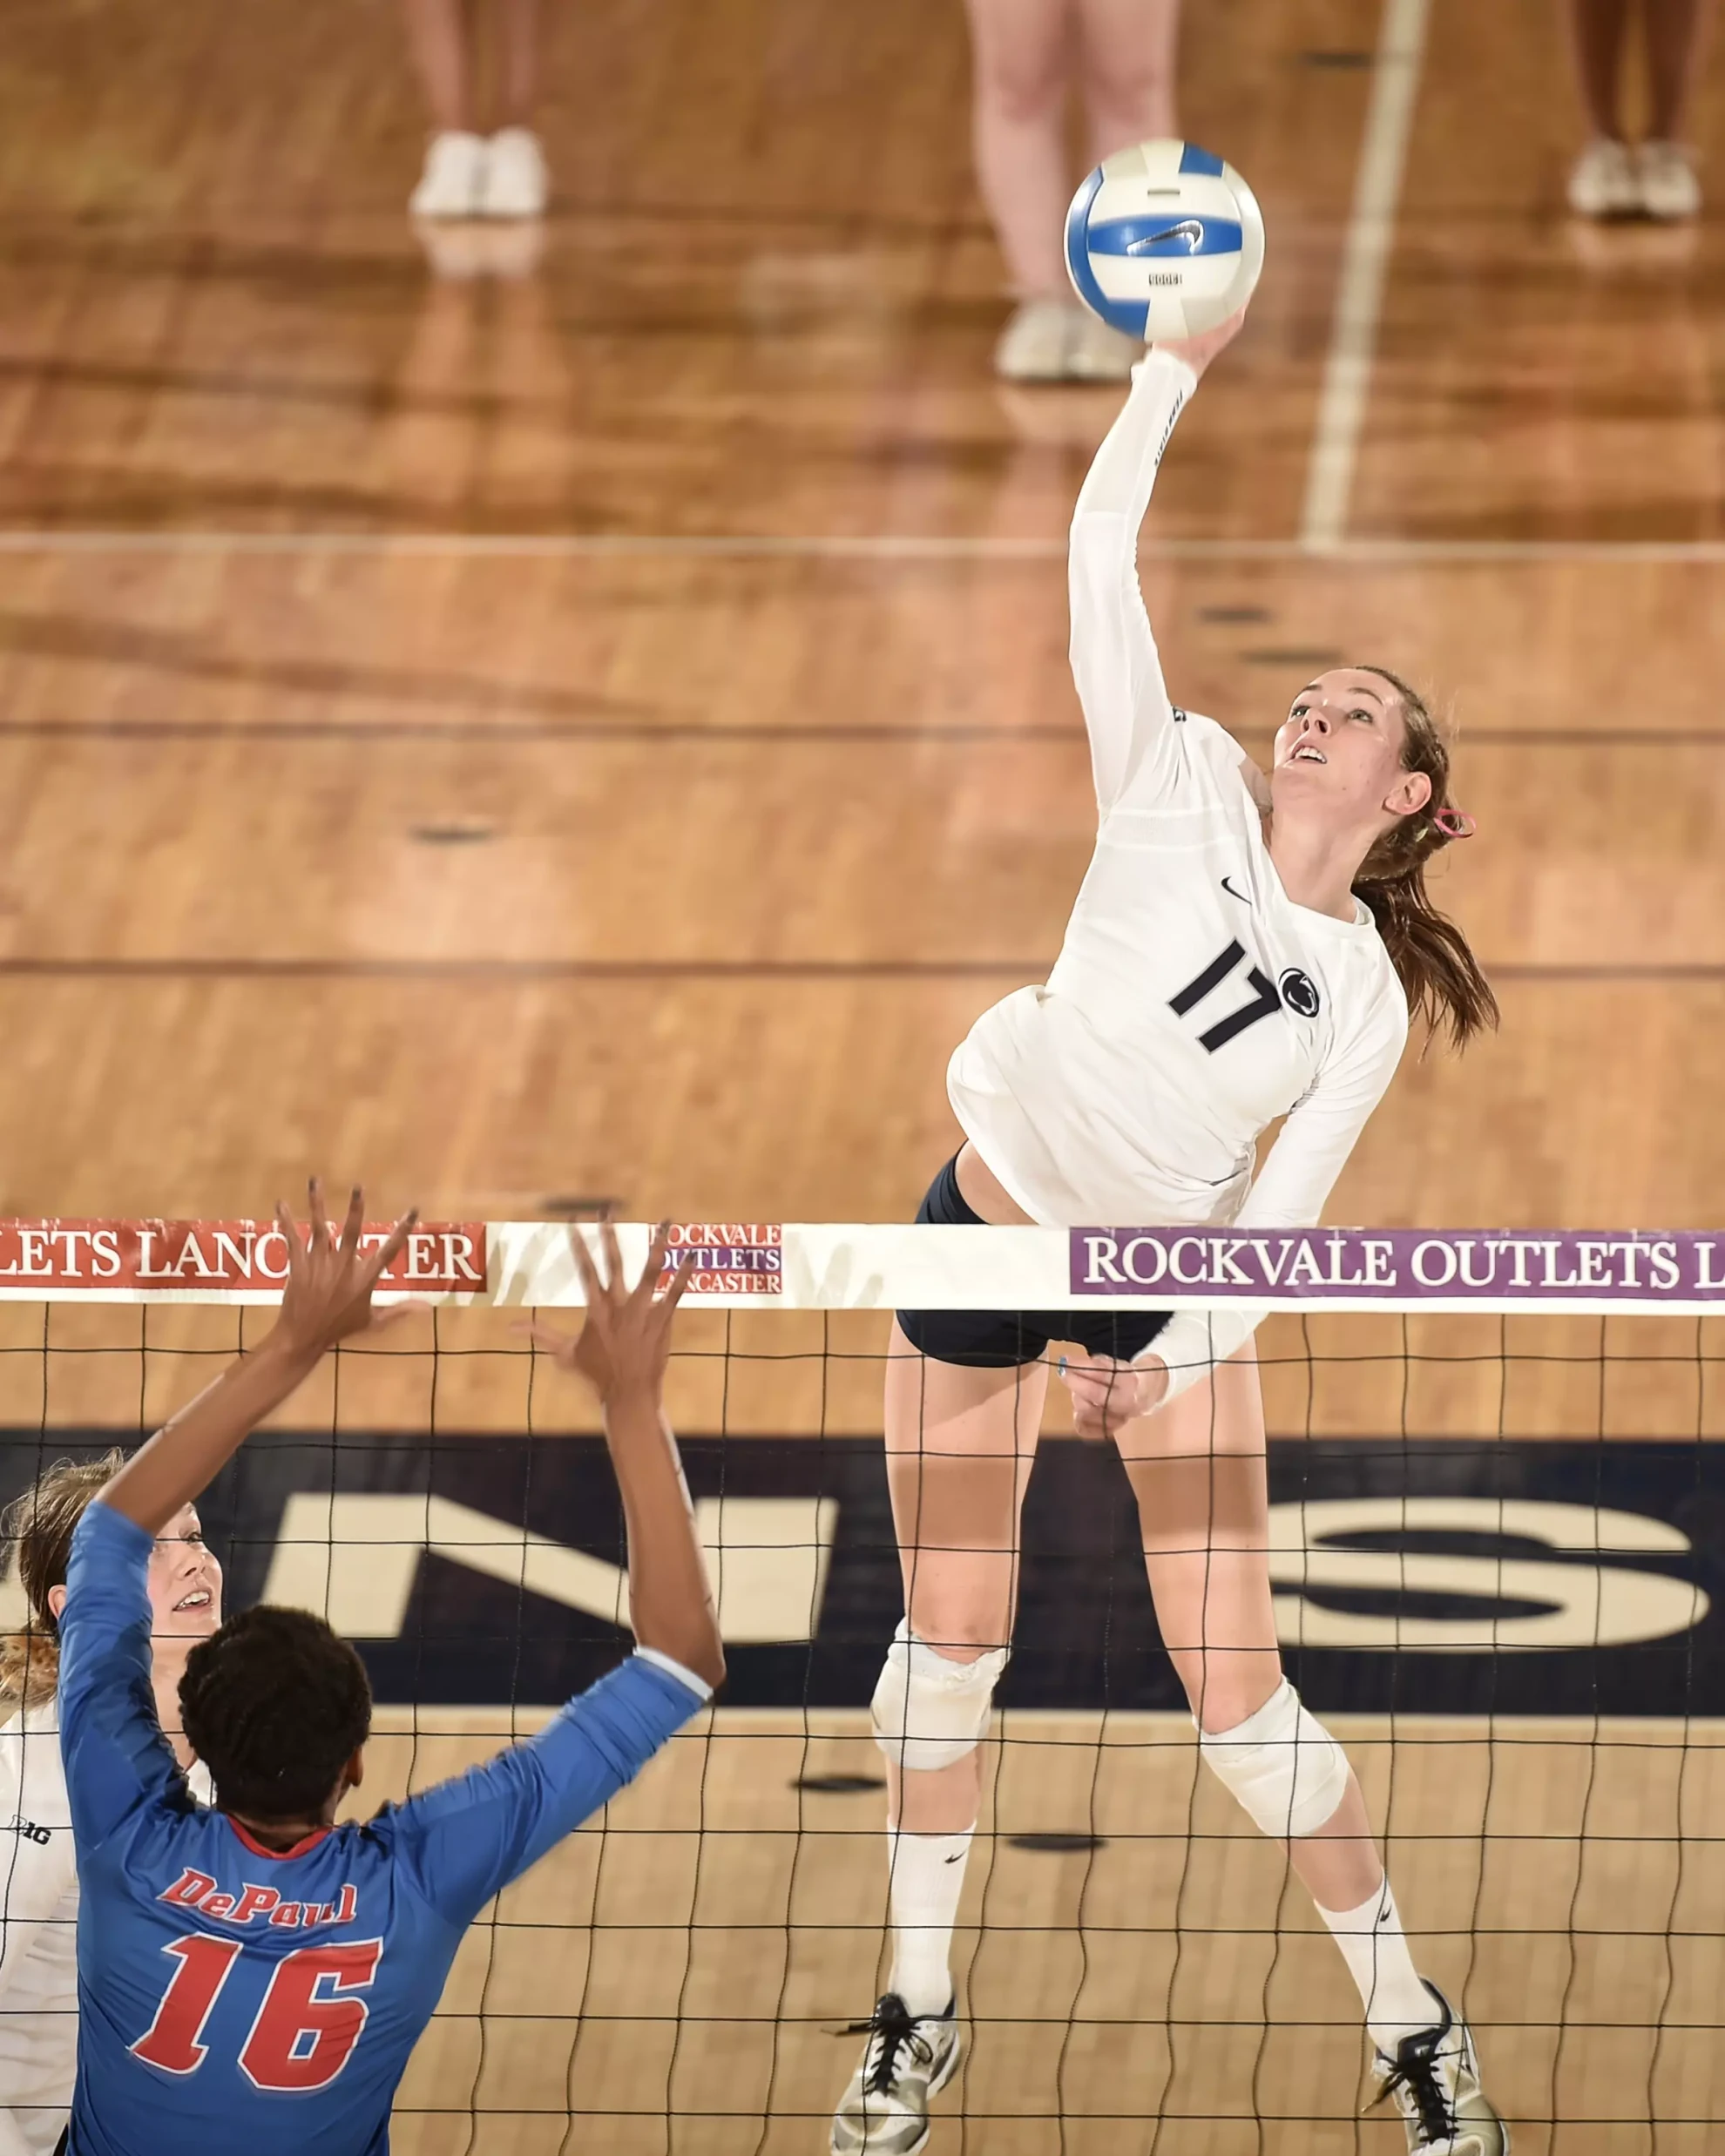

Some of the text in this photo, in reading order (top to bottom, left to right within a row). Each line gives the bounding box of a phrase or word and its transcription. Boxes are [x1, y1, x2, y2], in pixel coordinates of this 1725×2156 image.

[1166, 936, 1282, 1056] 17
[1083, 1236, 1397, 1288] ROCKVALE
[1410, 1240, 1681, 1289] OUTLETS
[155, 1867, 357, 1928] DePaul
[125, 1930, 383, 2091] 16
